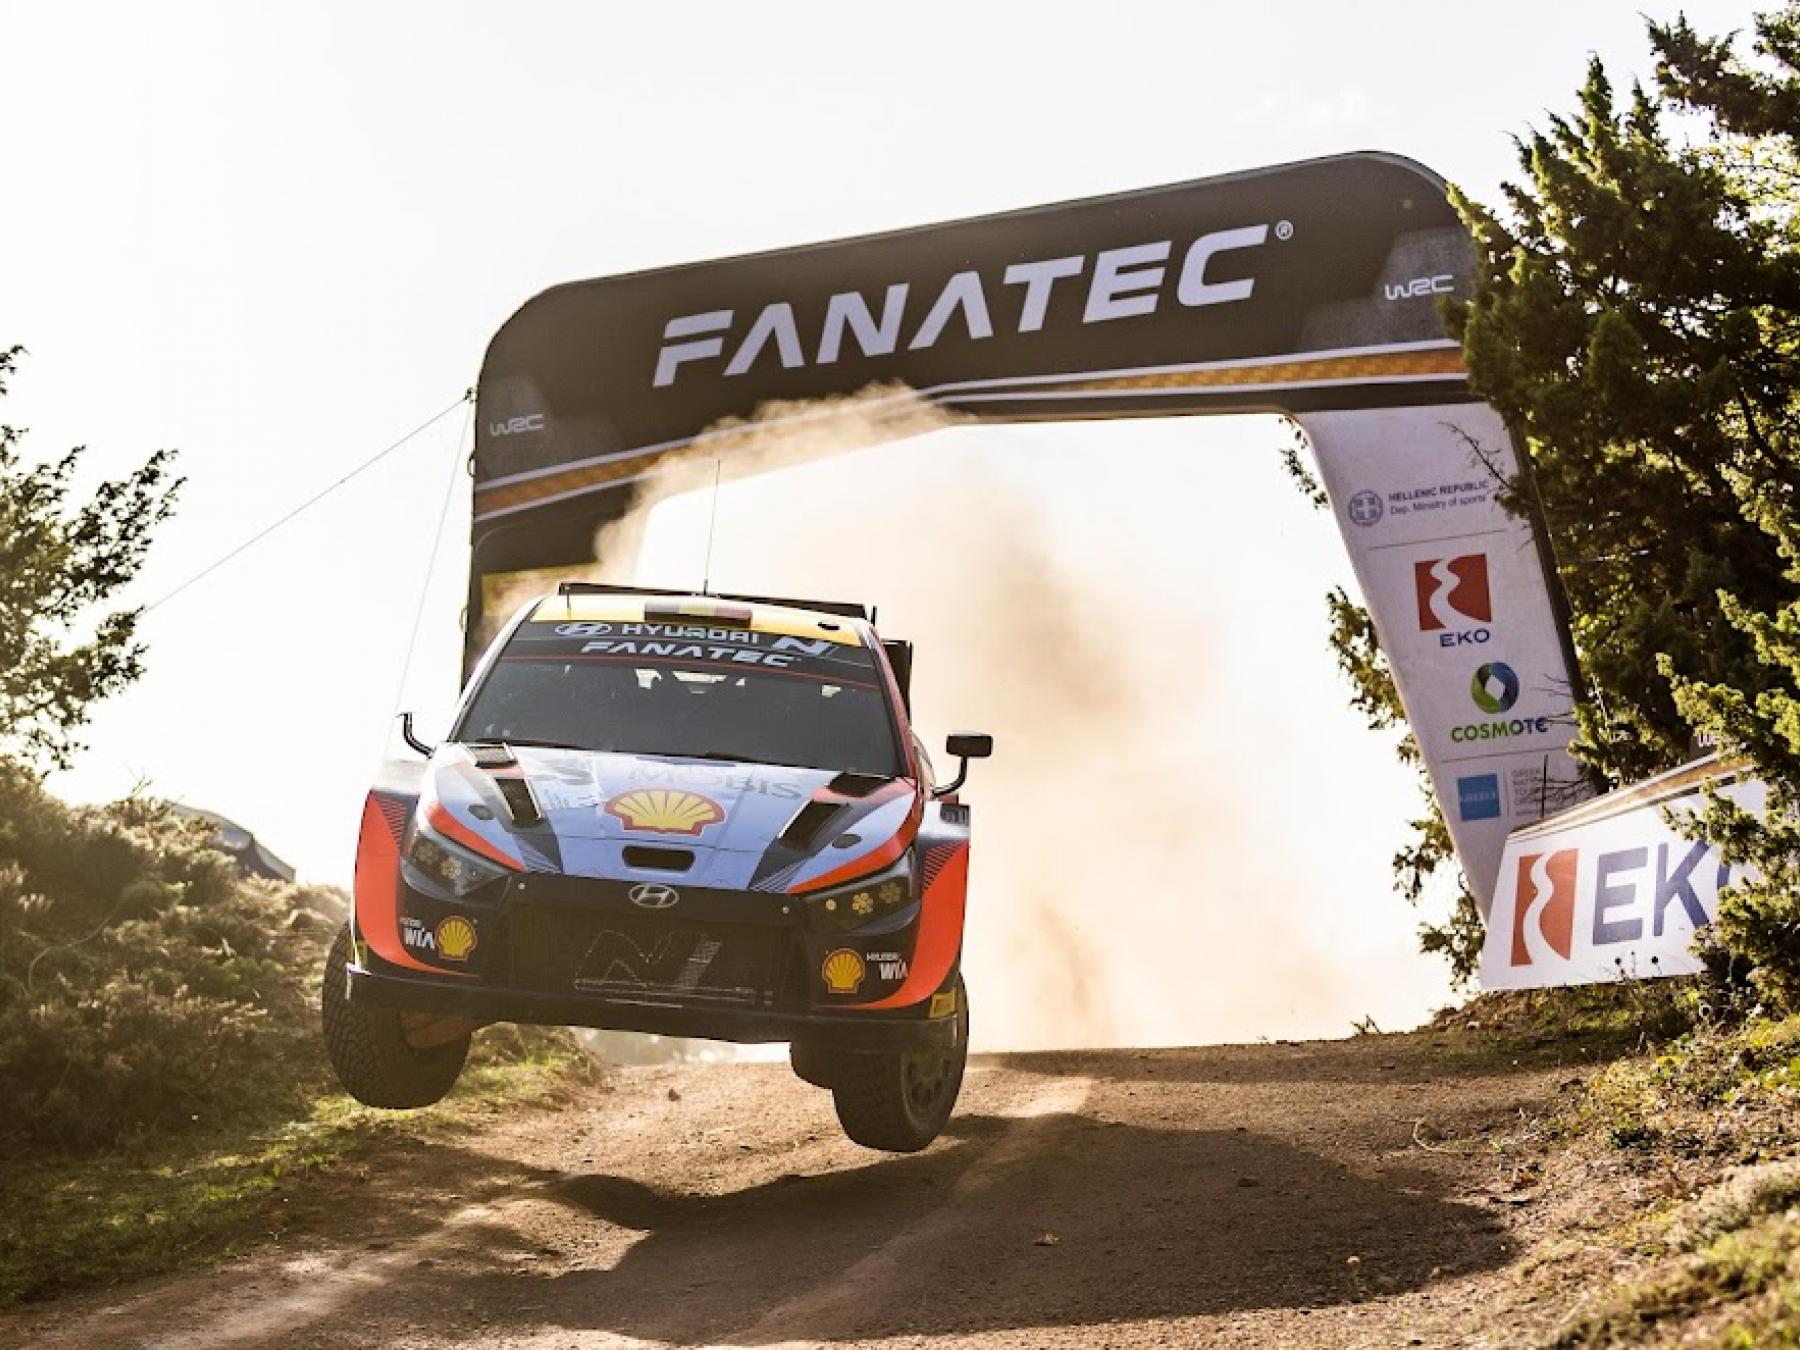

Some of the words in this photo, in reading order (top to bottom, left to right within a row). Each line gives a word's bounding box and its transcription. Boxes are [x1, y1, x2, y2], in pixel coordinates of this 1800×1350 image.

[1388, 486, 1437, 502] HELLENIC
[1439, 478, 1489, 496] REPUBLIC
[621, 623, 759, 644] HYUNDAI
[1439, 628, 1491, 648] EKO
[580, 640, 798, 668] FANATEC
[1450, 716, 1549, 743] COSMOTE
[1592, 838, 1731, 947] EK
